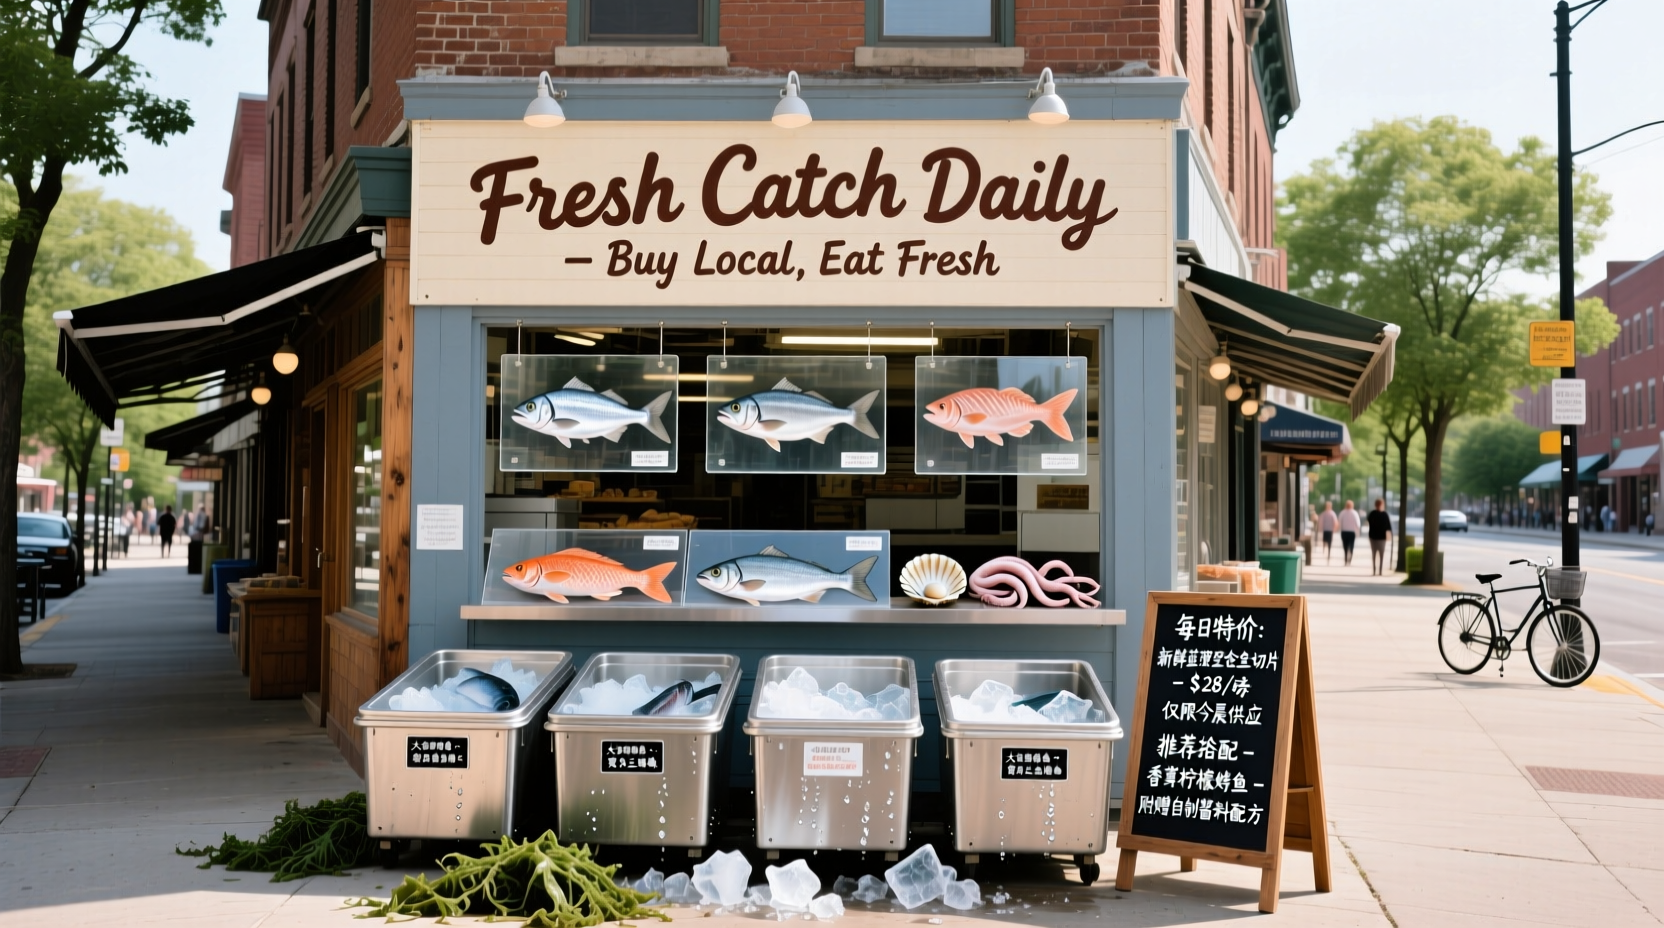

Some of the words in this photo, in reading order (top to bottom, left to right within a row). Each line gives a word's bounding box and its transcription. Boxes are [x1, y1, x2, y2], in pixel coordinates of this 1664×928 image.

[469, 151, 685, 245] Fresh
[701, 143, 907, 227] Catch
[921, 146, 1119, 251] Daily
[606, 239, 678, 290] Buy
[693, 239, 805, 282] Local,
[819, 239, 885, 276] Eat
[897, 239, 1001, 278] Fresh
